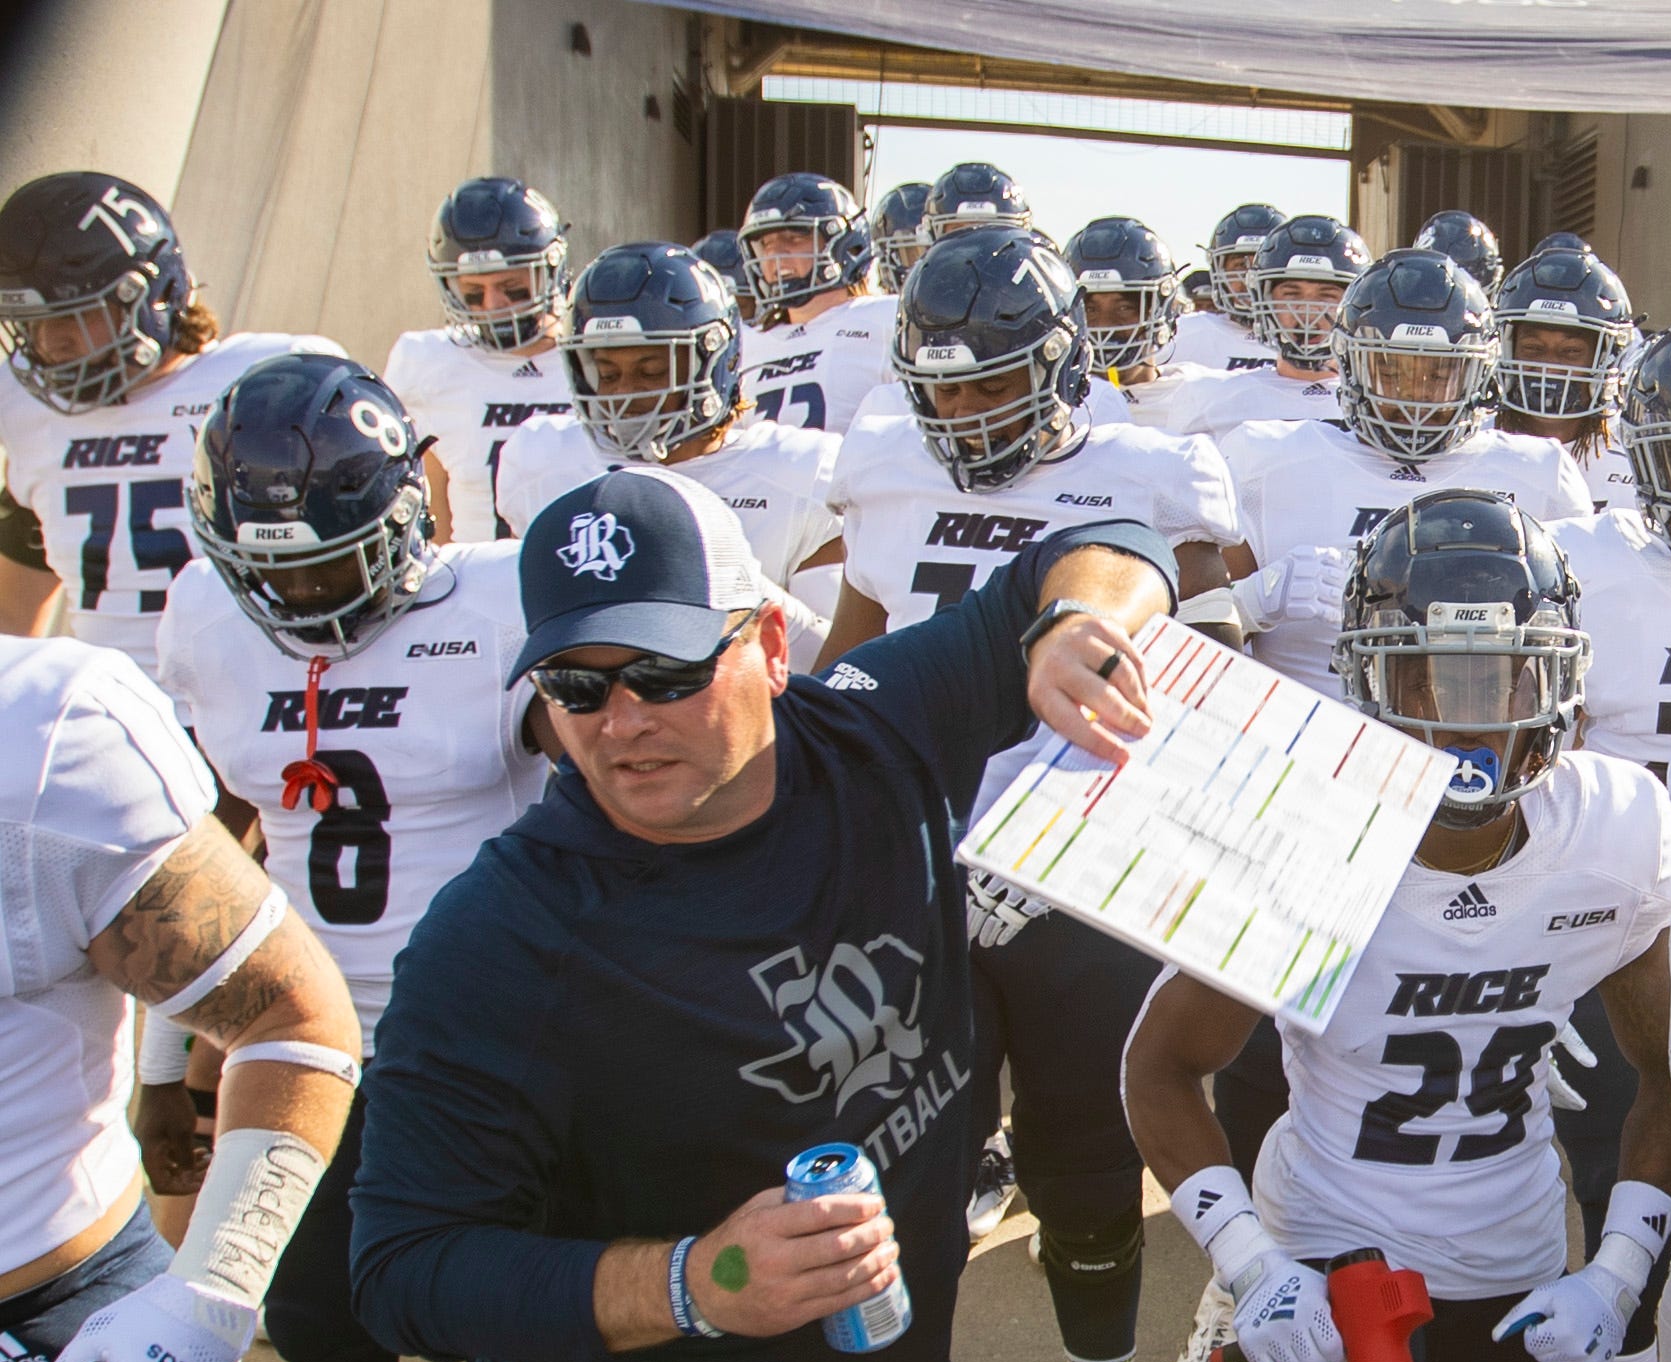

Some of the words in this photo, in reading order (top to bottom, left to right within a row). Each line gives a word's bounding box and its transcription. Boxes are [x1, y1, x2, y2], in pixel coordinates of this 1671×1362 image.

[79, 187, 159, 257] 75
[1088, 270, 1111, 280] RICE
[1298, 256, 1322, 266] RICE
[1012, 246, 1071, 316] 70
[1540, 300, 1566, 311] RICE
[596, 318, 625, 330] RICE
[1405, 325, 1435, 337] RICE
[757, 349, 823, 382] RICE
[926, 347, 957, 361] RICE
[1302, 389, 1332, 397] adidas
[349, 399, 408, 458] 8
[63, 434, 168, 468] RICE
[1389, 472, 1427, 483] adidas
[64, 478, 195, 613] 75
[255, 528, 294, 541] RICE
[926, 511, 1049, 553] RICE
[1455, 609, 1488, 622] RICE
[834, 661, 879, 691] adidas
[261, 686, 409, 732] RICE
[308, 749, 391, 925] 8
[1443, 903, 1497, 921] adidas
[1385, 963, 1551, 1018] RICE
[1352, 1020, 1558, 1166] 29
[864, 1050, 971, 1171] TBALL
[242, 1144, 319, 1226] Uncle
[1252, 1276, 1300, 1329] adidas
